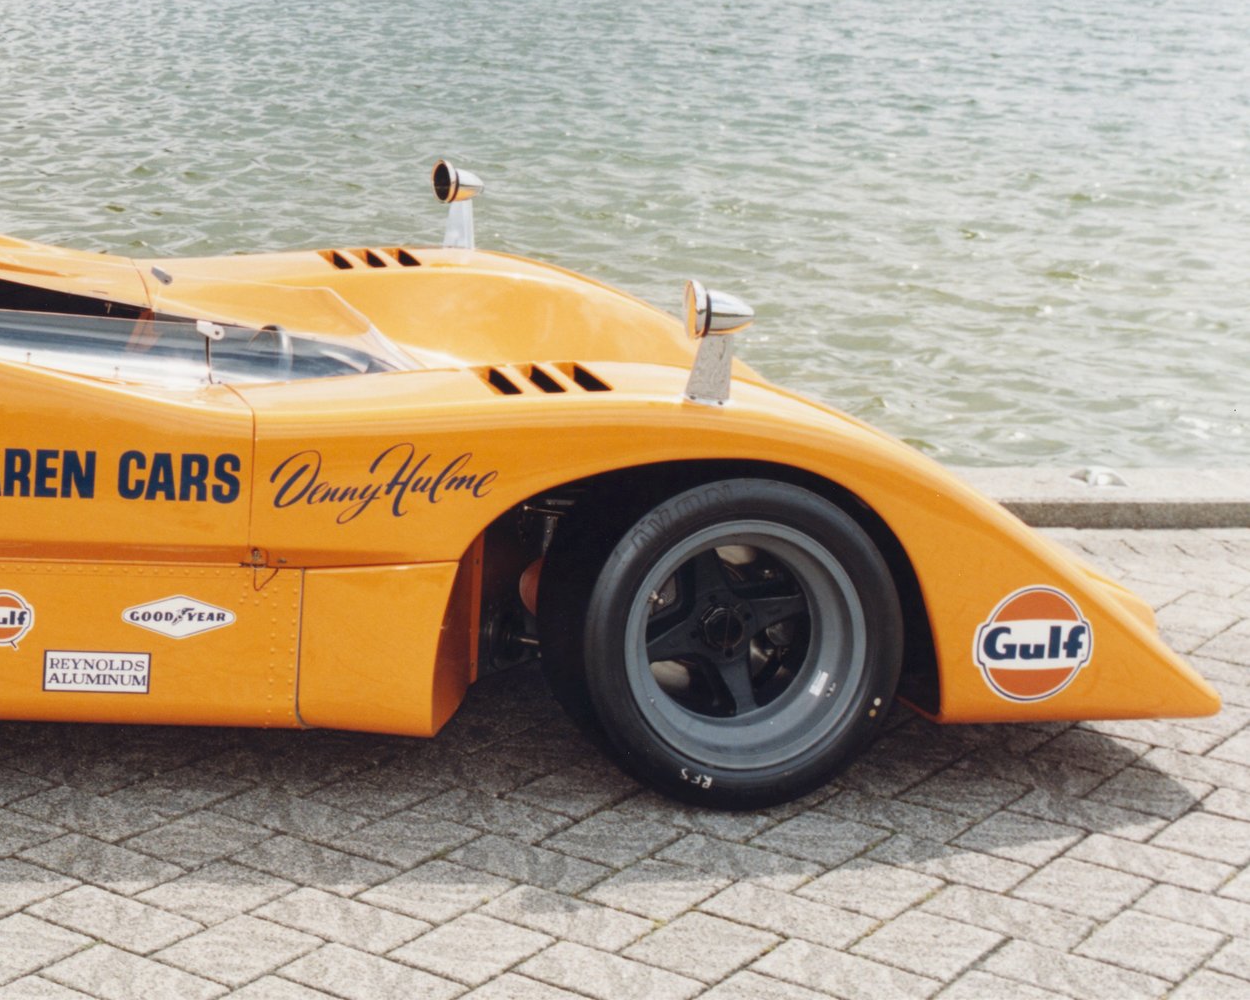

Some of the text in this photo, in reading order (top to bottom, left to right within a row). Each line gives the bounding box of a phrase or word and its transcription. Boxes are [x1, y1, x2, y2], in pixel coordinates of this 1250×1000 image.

[116, 449, 242, 504] CARS
[269, 442, 499, 525] Denny Hulme
[983, 625, 1086, 660] Gulf
[48, 672, 146, 687] ALUMINUM
[49, 657, 146, 672] REYNOLDS
